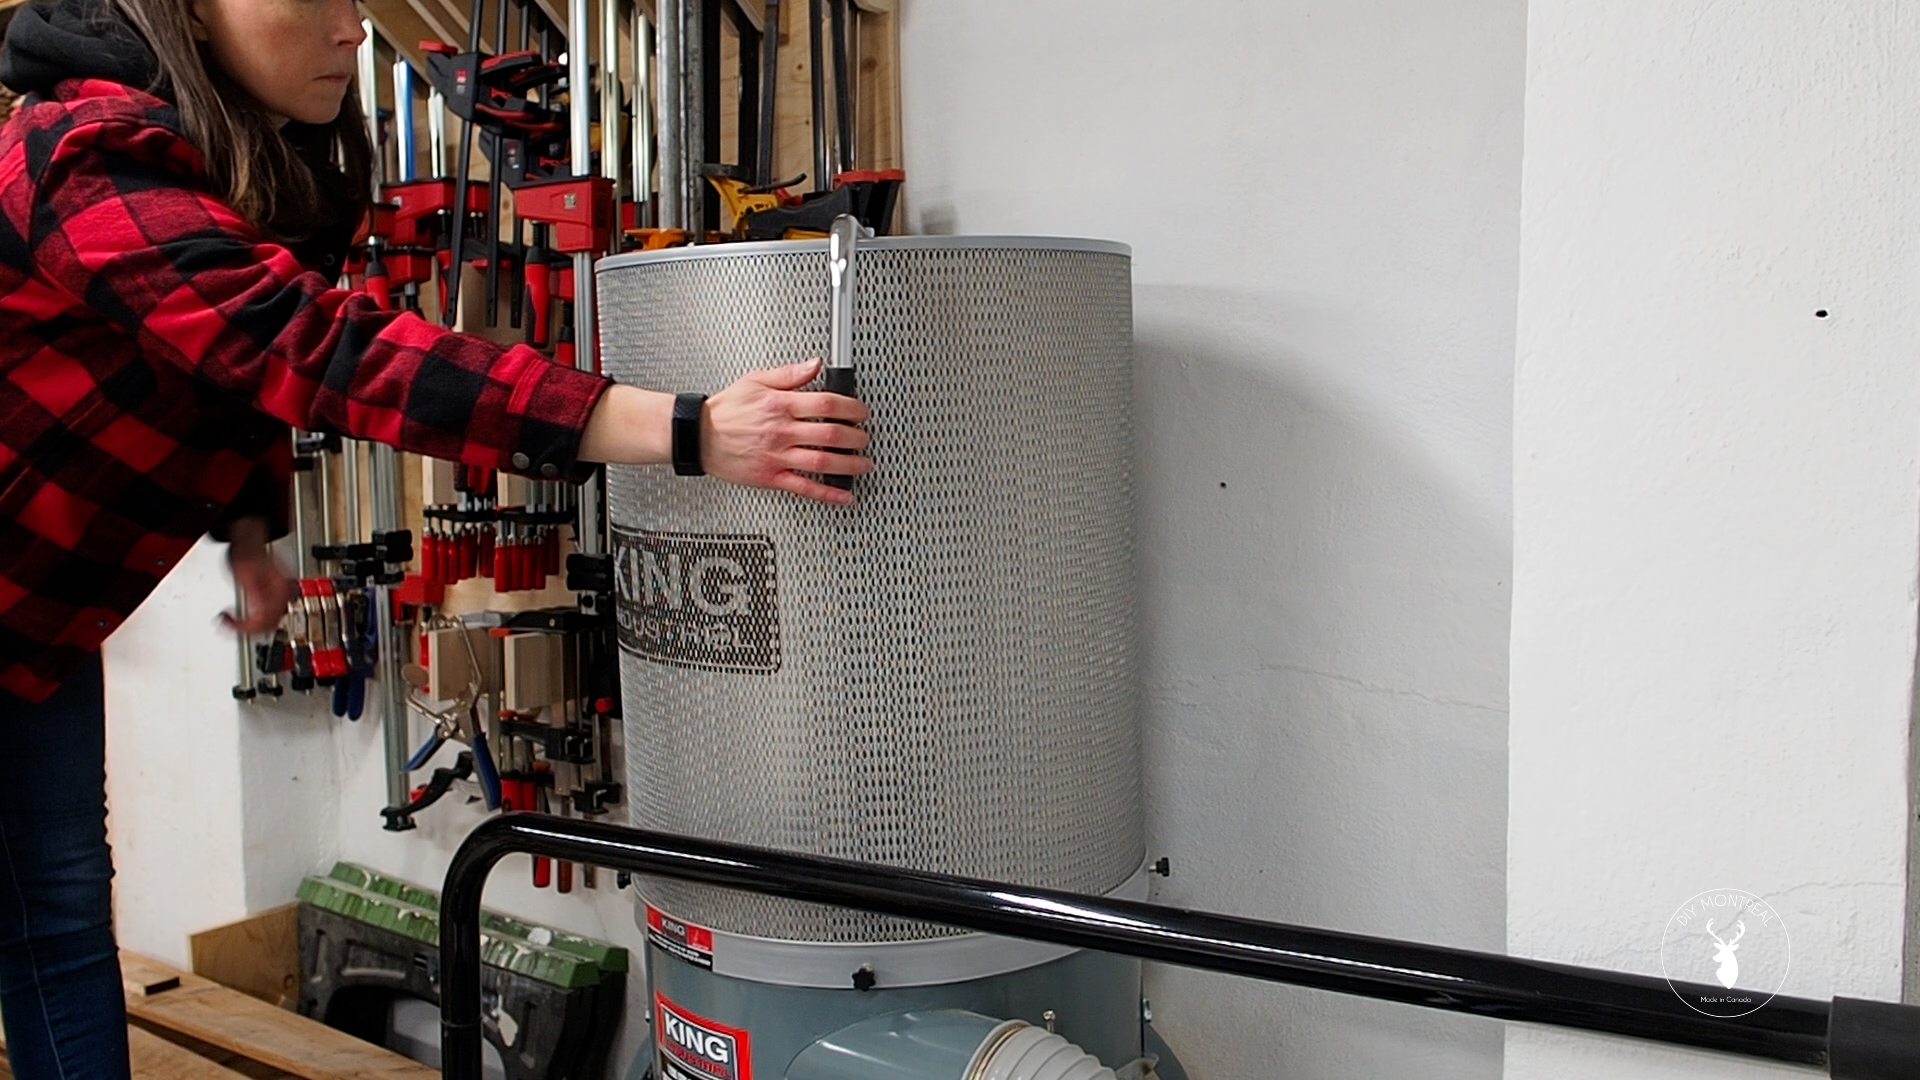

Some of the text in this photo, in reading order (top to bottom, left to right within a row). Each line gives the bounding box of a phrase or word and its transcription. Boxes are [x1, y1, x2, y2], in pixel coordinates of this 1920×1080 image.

[613, 543, 751, 616] KING
[661, 917, 686, 936] KING
[664, 1012, 729, 1064] KING
